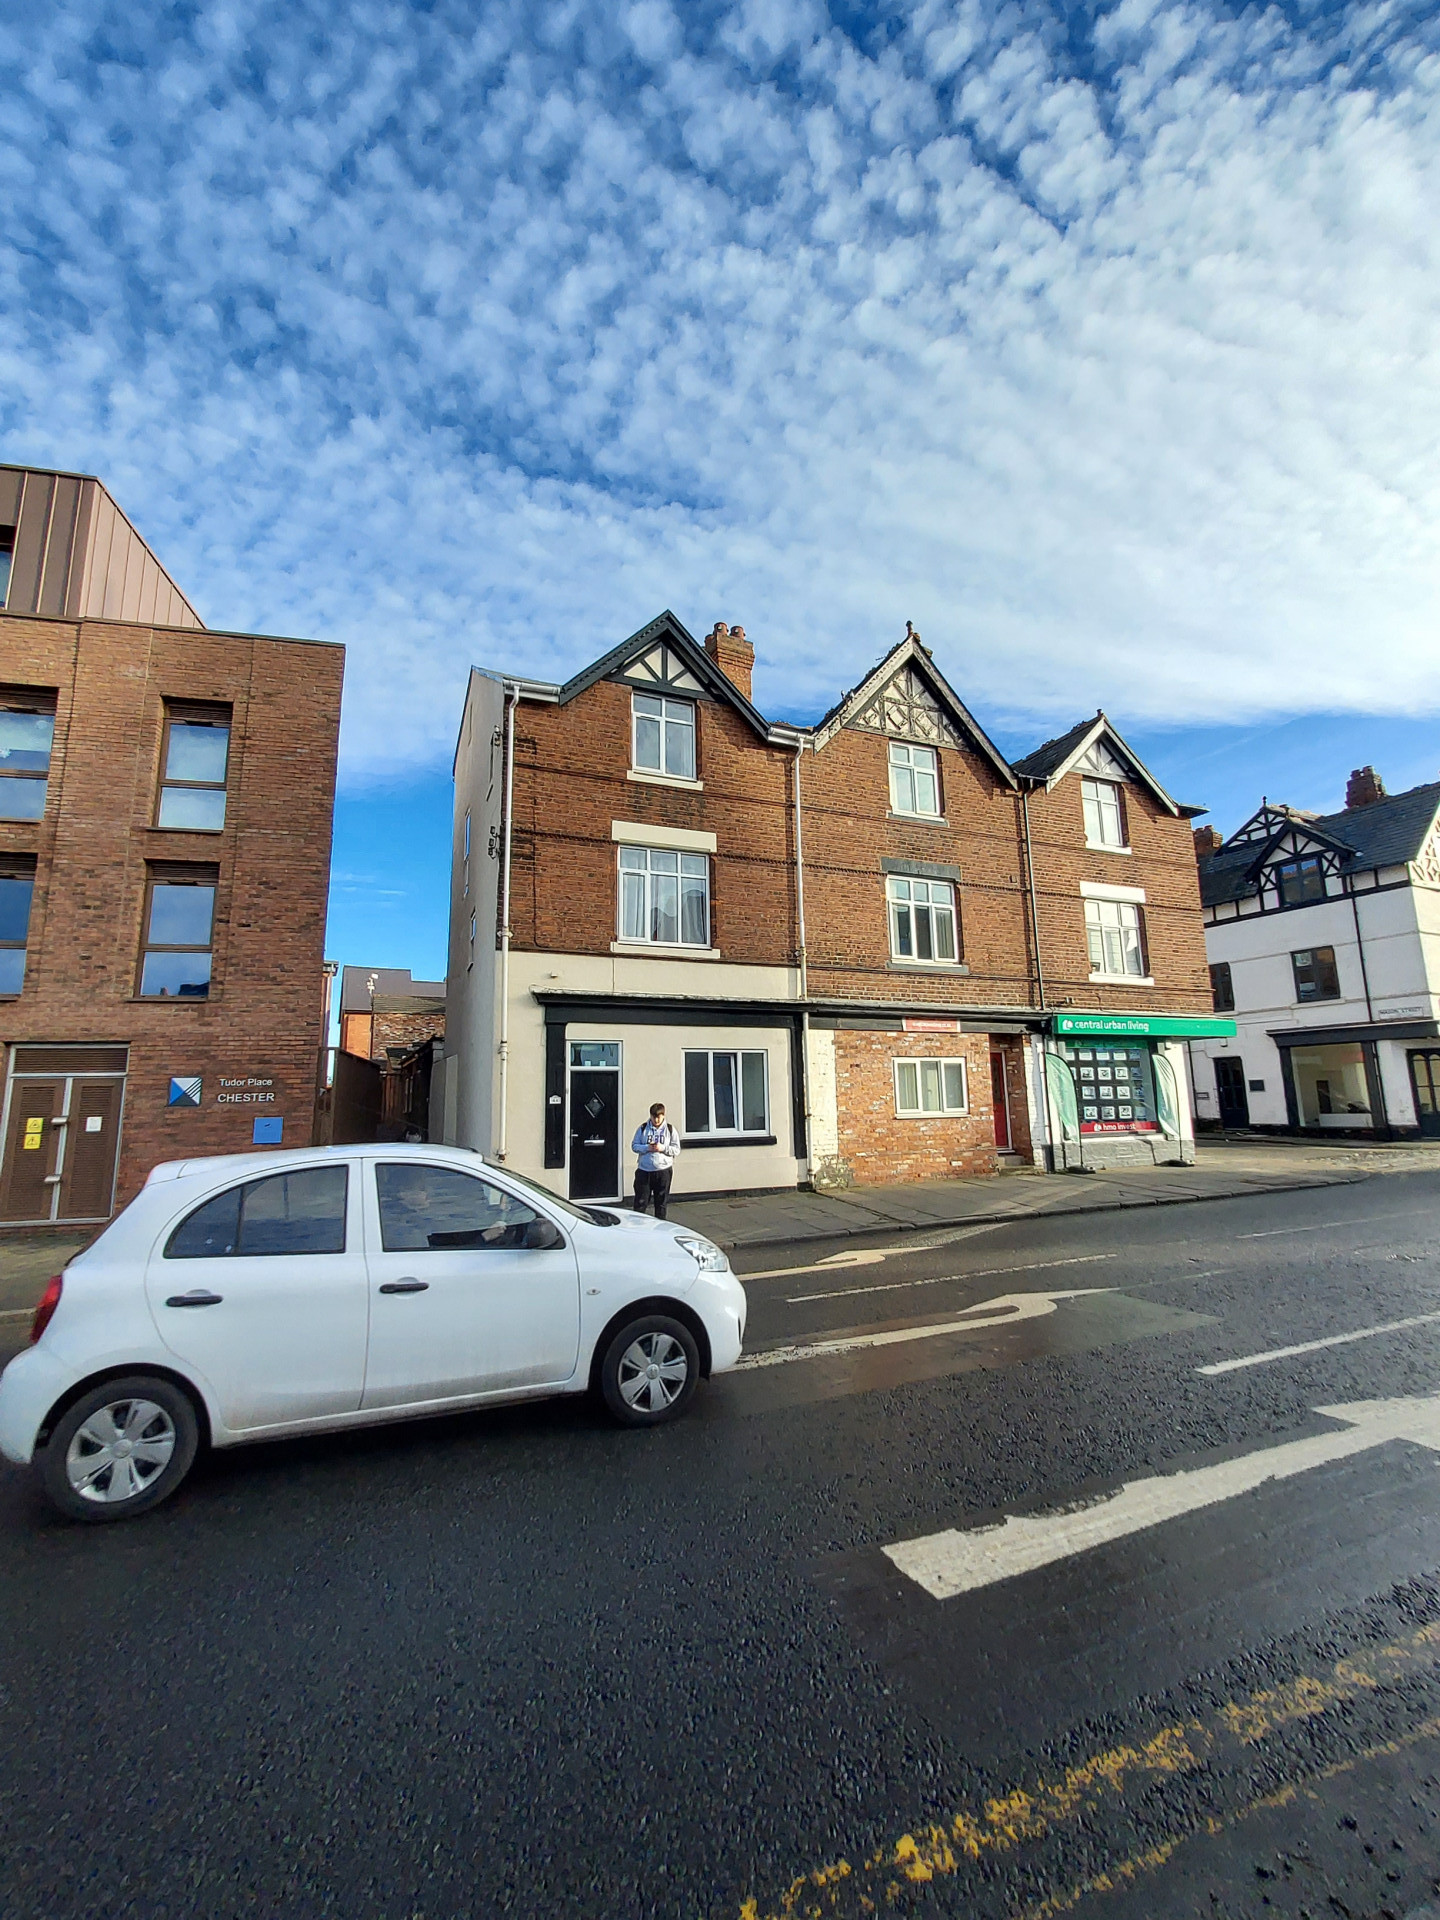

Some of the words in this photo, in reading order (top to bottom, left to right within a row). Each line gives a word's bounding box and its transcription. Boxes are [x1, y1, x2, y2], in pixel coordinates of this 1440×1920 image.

[1074, 1020, 1103, 1029] central
[1103, 1020, 1127, 1030] urban
[1127, 1021, 1150, 1033] living
[219, 1078, 246, 1087] Tudor
[247, 1078, 273, 1086] Place
[217, 1092, 275, 1103] CHESTER
[1102, 1123, 1117, 1131] hmo
[1117, 1122, 1137, 1130] invest
